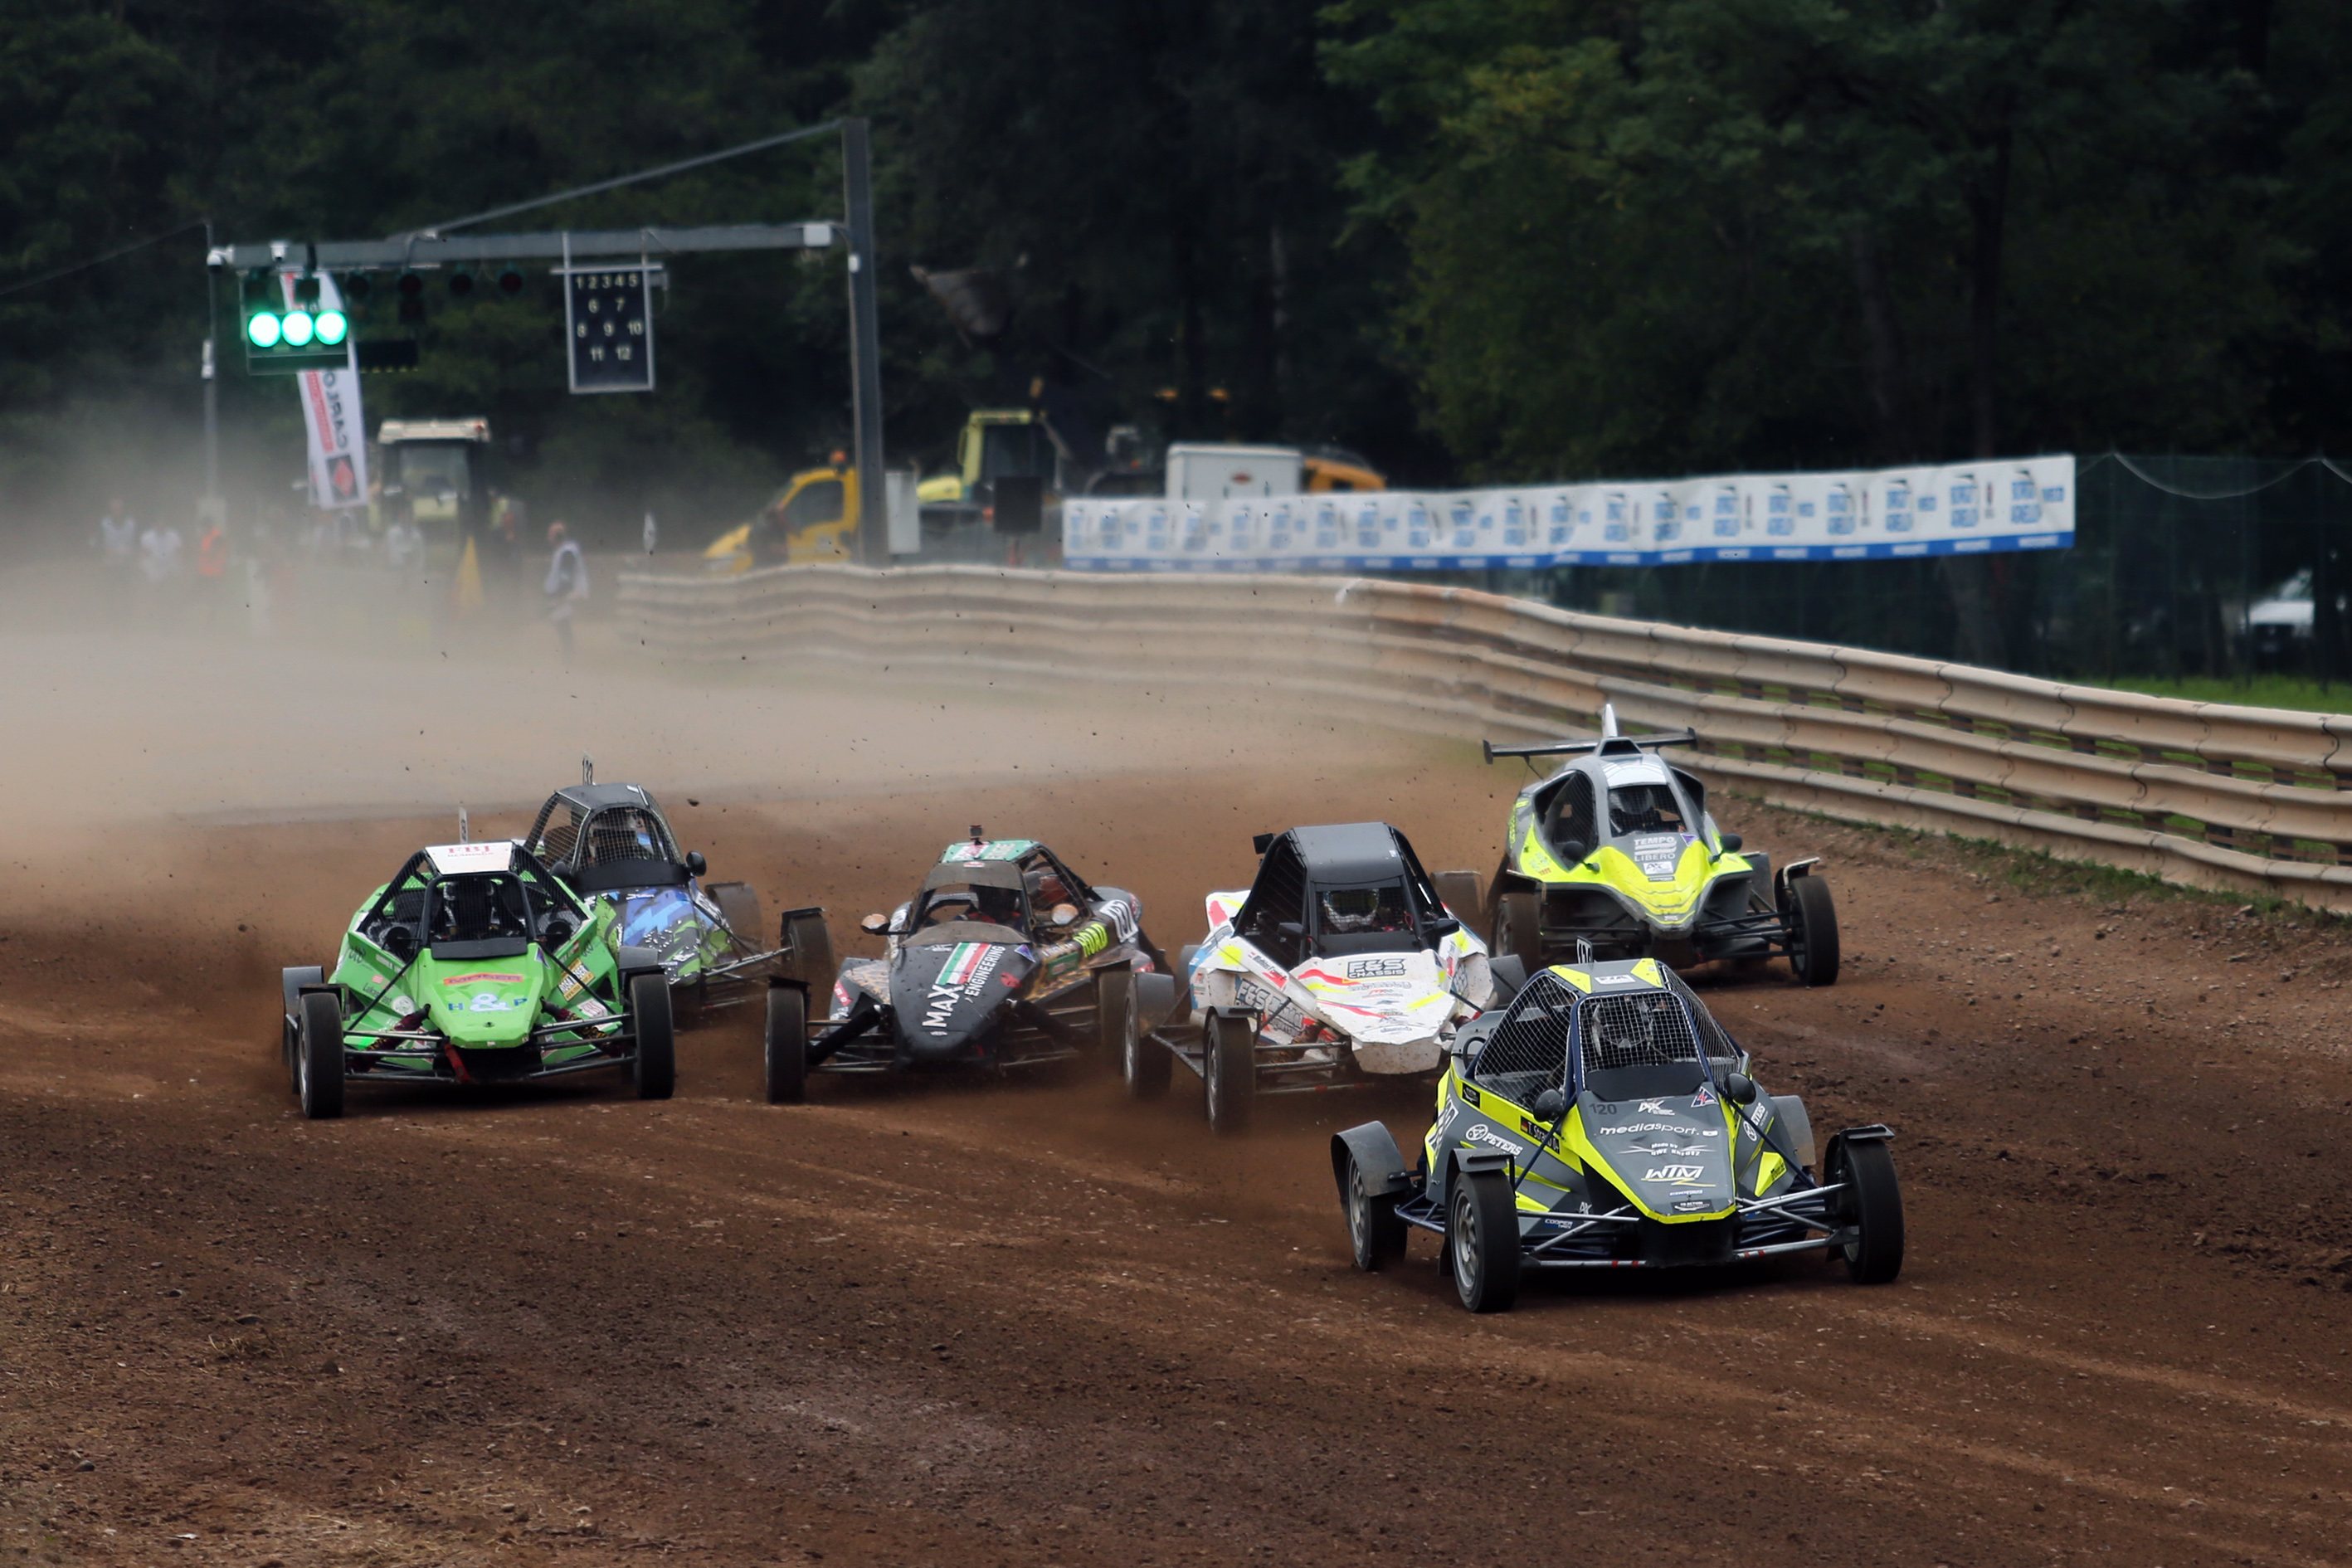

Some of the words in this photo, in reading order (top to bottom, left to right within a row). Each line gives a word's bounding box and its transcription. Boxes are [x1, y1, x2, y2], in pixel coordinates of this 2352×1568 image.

[576, 275, 584, 290] 1
[588, 275, 597, 289] 2
[601, 275, 611, 289] 3
[615, 274, 625, 287] 4
[628, 273, 638, 287] 5
[588, 299, 599, 314] 6
[616, 296, 626, 312] 7
[577, 323, 587, 338] 8
[603, 320, 615, 337] 9
[627, 320, 644, 335] 10
[590, 346, 604, 362] 11
[616, 345, 631, 360] 12
[1634, 836, 1675, 846] TEMPO
[1634, 853, 1675, 862] LIBERO
[965, 945, 1006, 996] ENGINEERING
[1347, 958, 1405, 973] F&S
[1348, 969, 1406, 978] CHASSIS
[448, 1002, 464, 1010] H
[470, 992, 513, 1011] &
[514, 998, 528, 1006] P
[922, 984, 965, 1028] MAX
[1589, 1103, 1617, 1115] 120
[1483, 1132, 1523, 1157] PETERS
